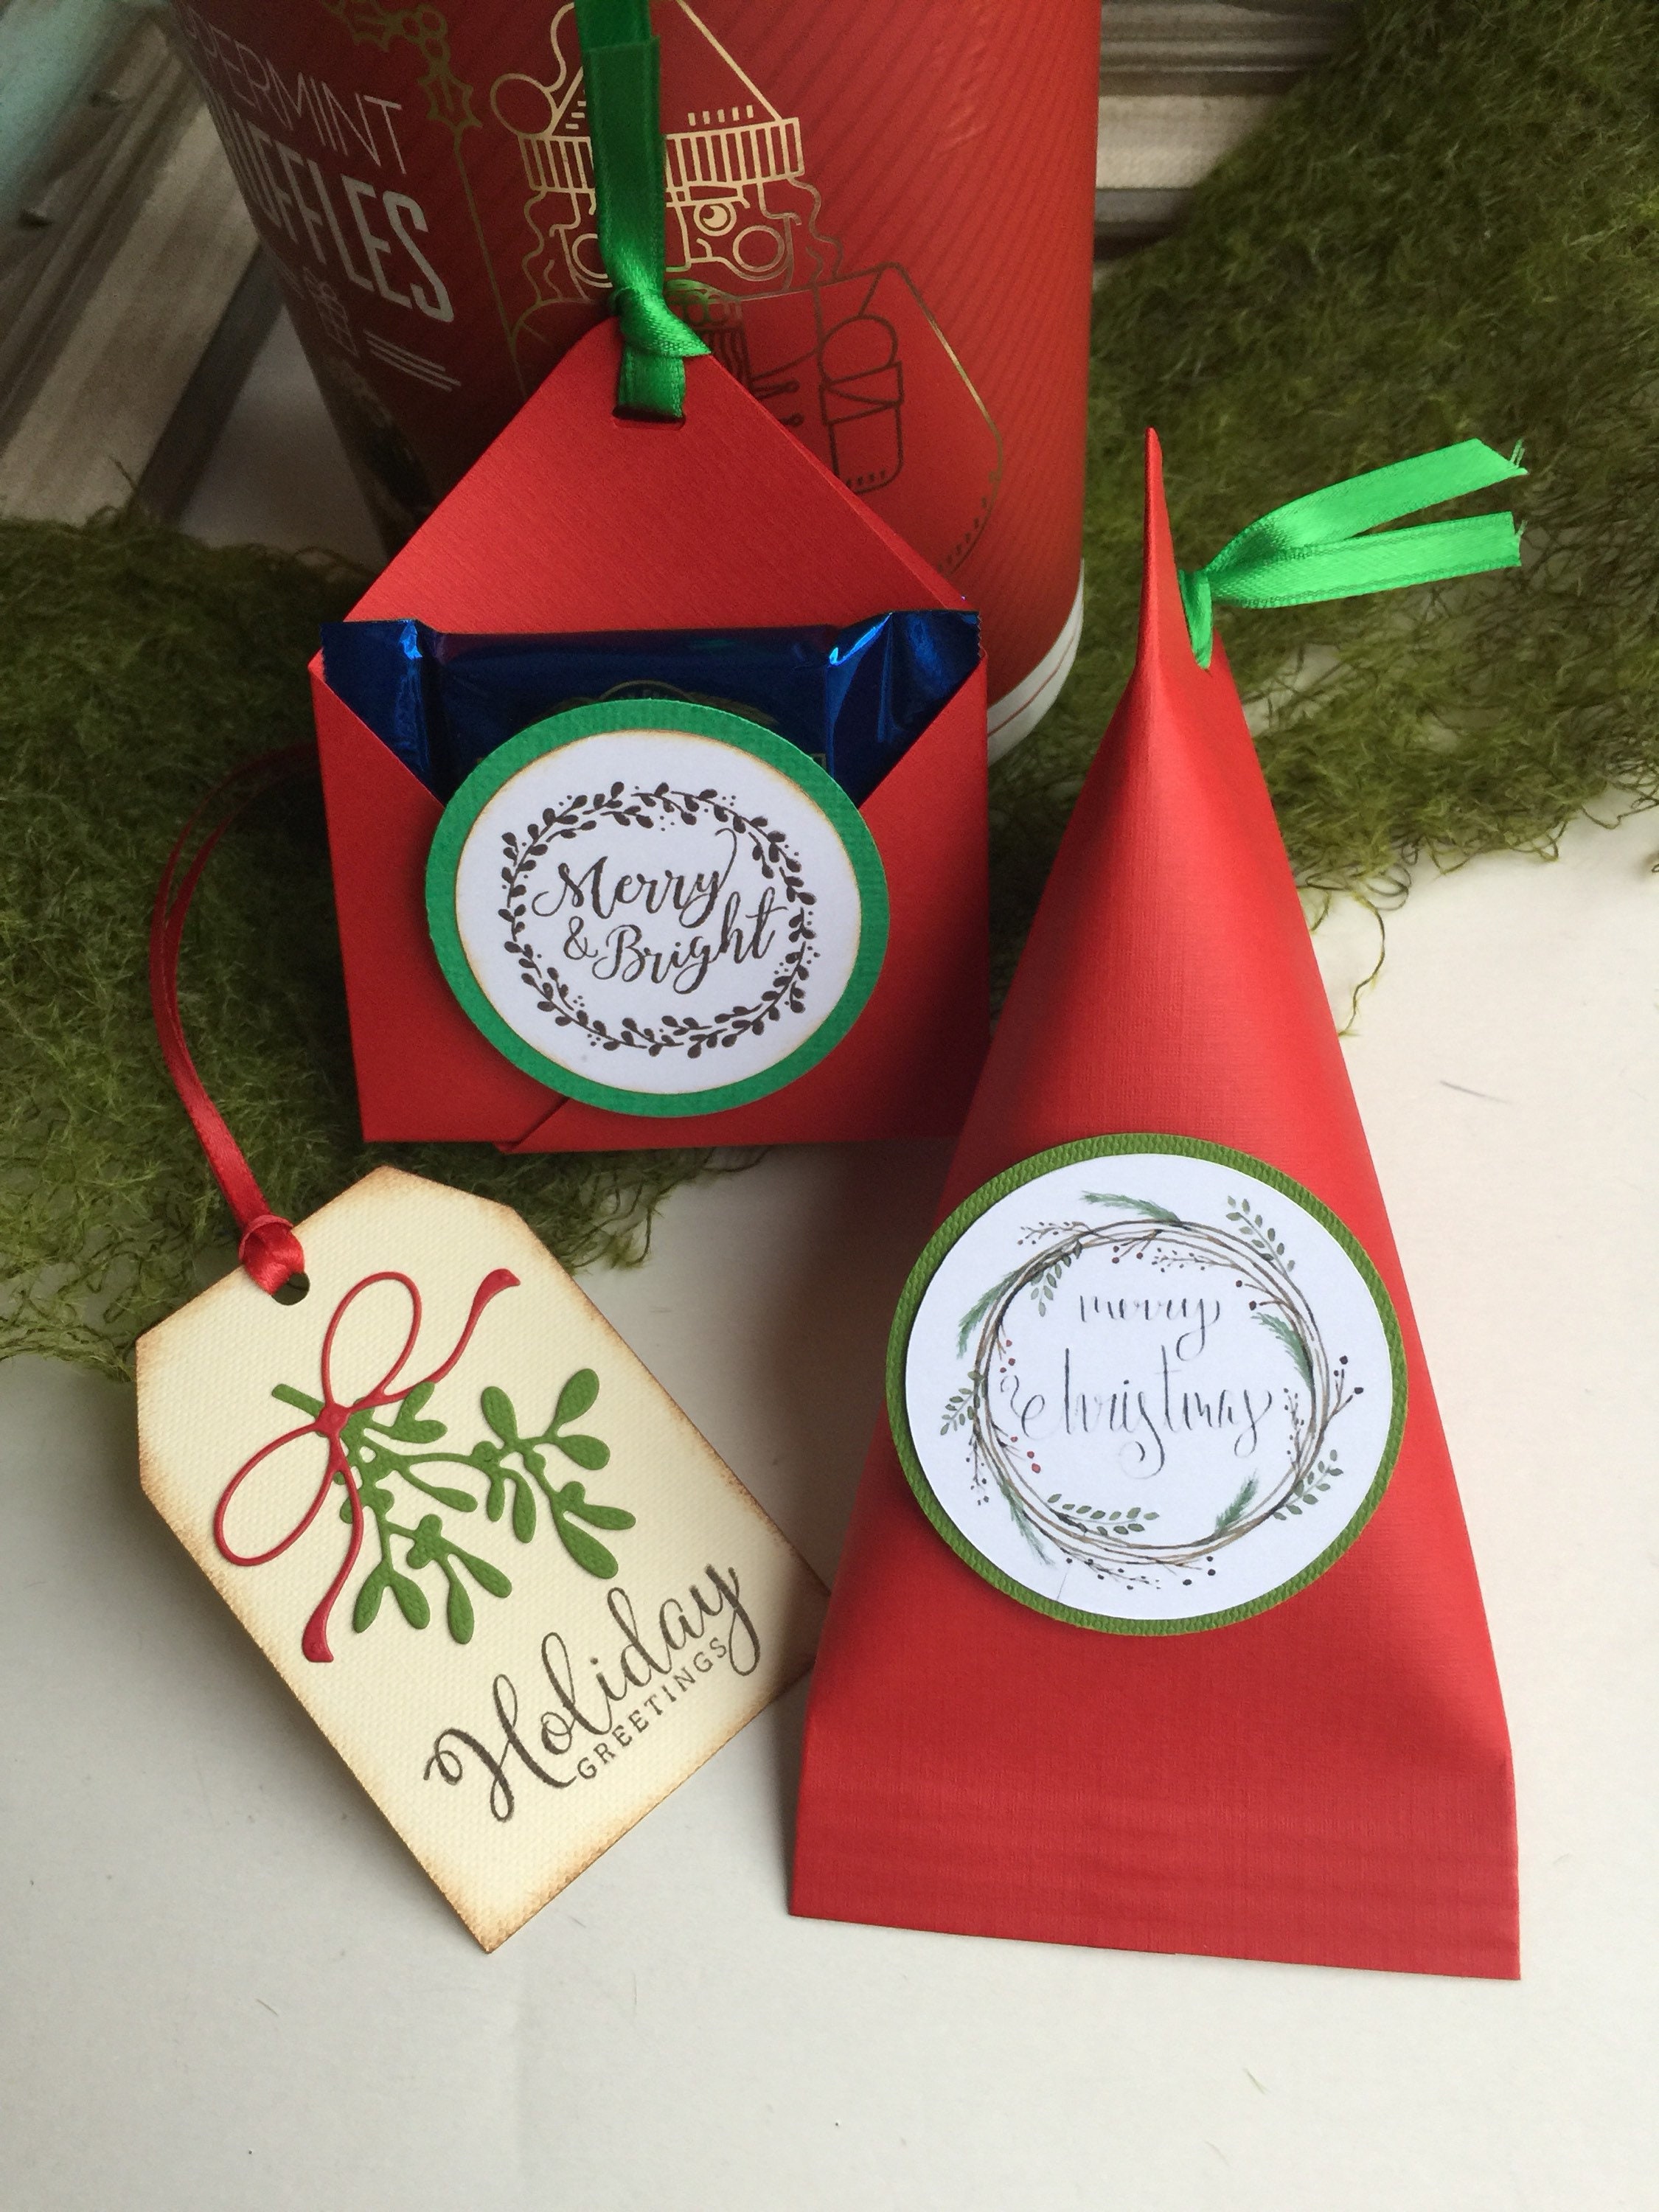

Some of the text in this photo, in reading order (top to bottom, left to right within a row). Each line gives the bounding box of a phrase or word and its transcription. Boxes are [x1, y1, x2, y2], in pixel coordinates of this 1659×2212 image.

[532, 827, 737, 929] Merry
[592, 887, 789, 995] Bright
[1079, 1294, 1221, 1361] merry
[423, 1563, 761, 1823] Holiday
[577, 1637, 728, 1780] GREETINGS
